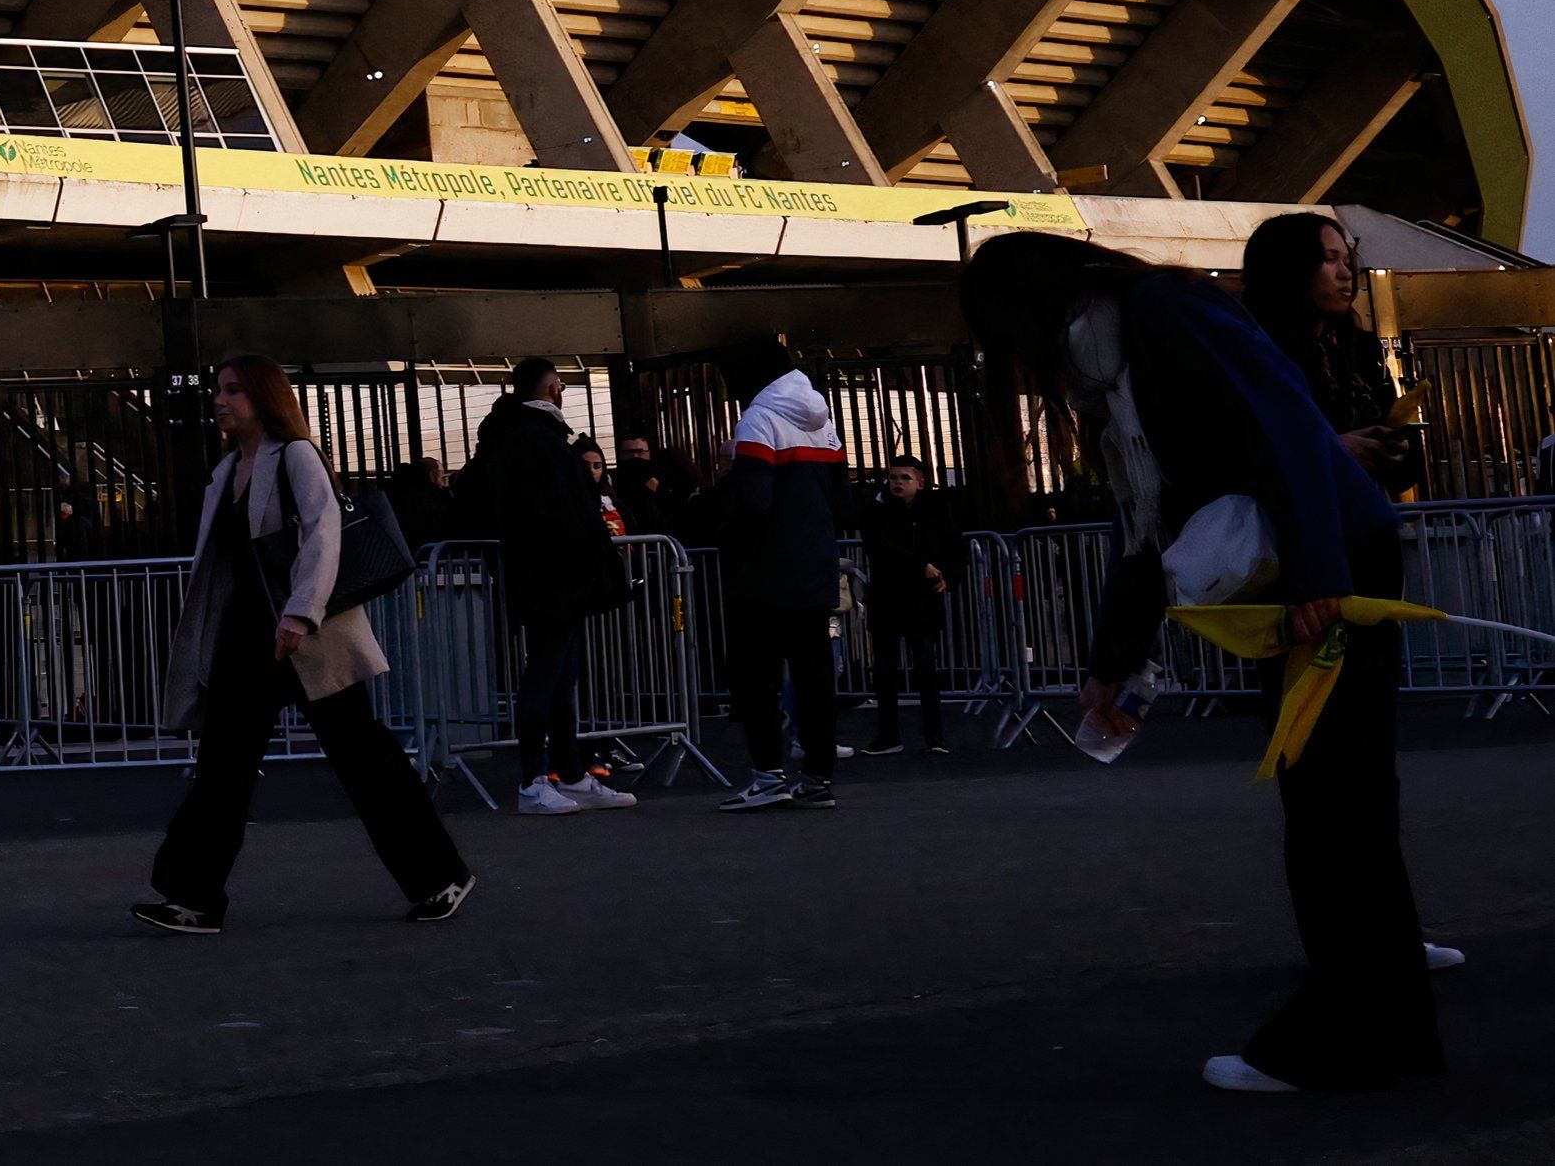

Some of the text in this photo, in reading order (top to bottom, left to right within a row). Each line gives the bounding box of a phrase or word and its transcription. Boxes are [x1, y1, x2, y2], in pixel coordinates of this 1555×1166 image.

[14, 140, 66, 158] Nantes
[295, 159, 381, 190] Nantes
[504, 171, 623, 202] Partenaire
[705, 183, 735, 207] du
[732, 184, 763, 209] FC
[760, 185, 838, 213] Nantes
[171, 375, 183, 386] 37
